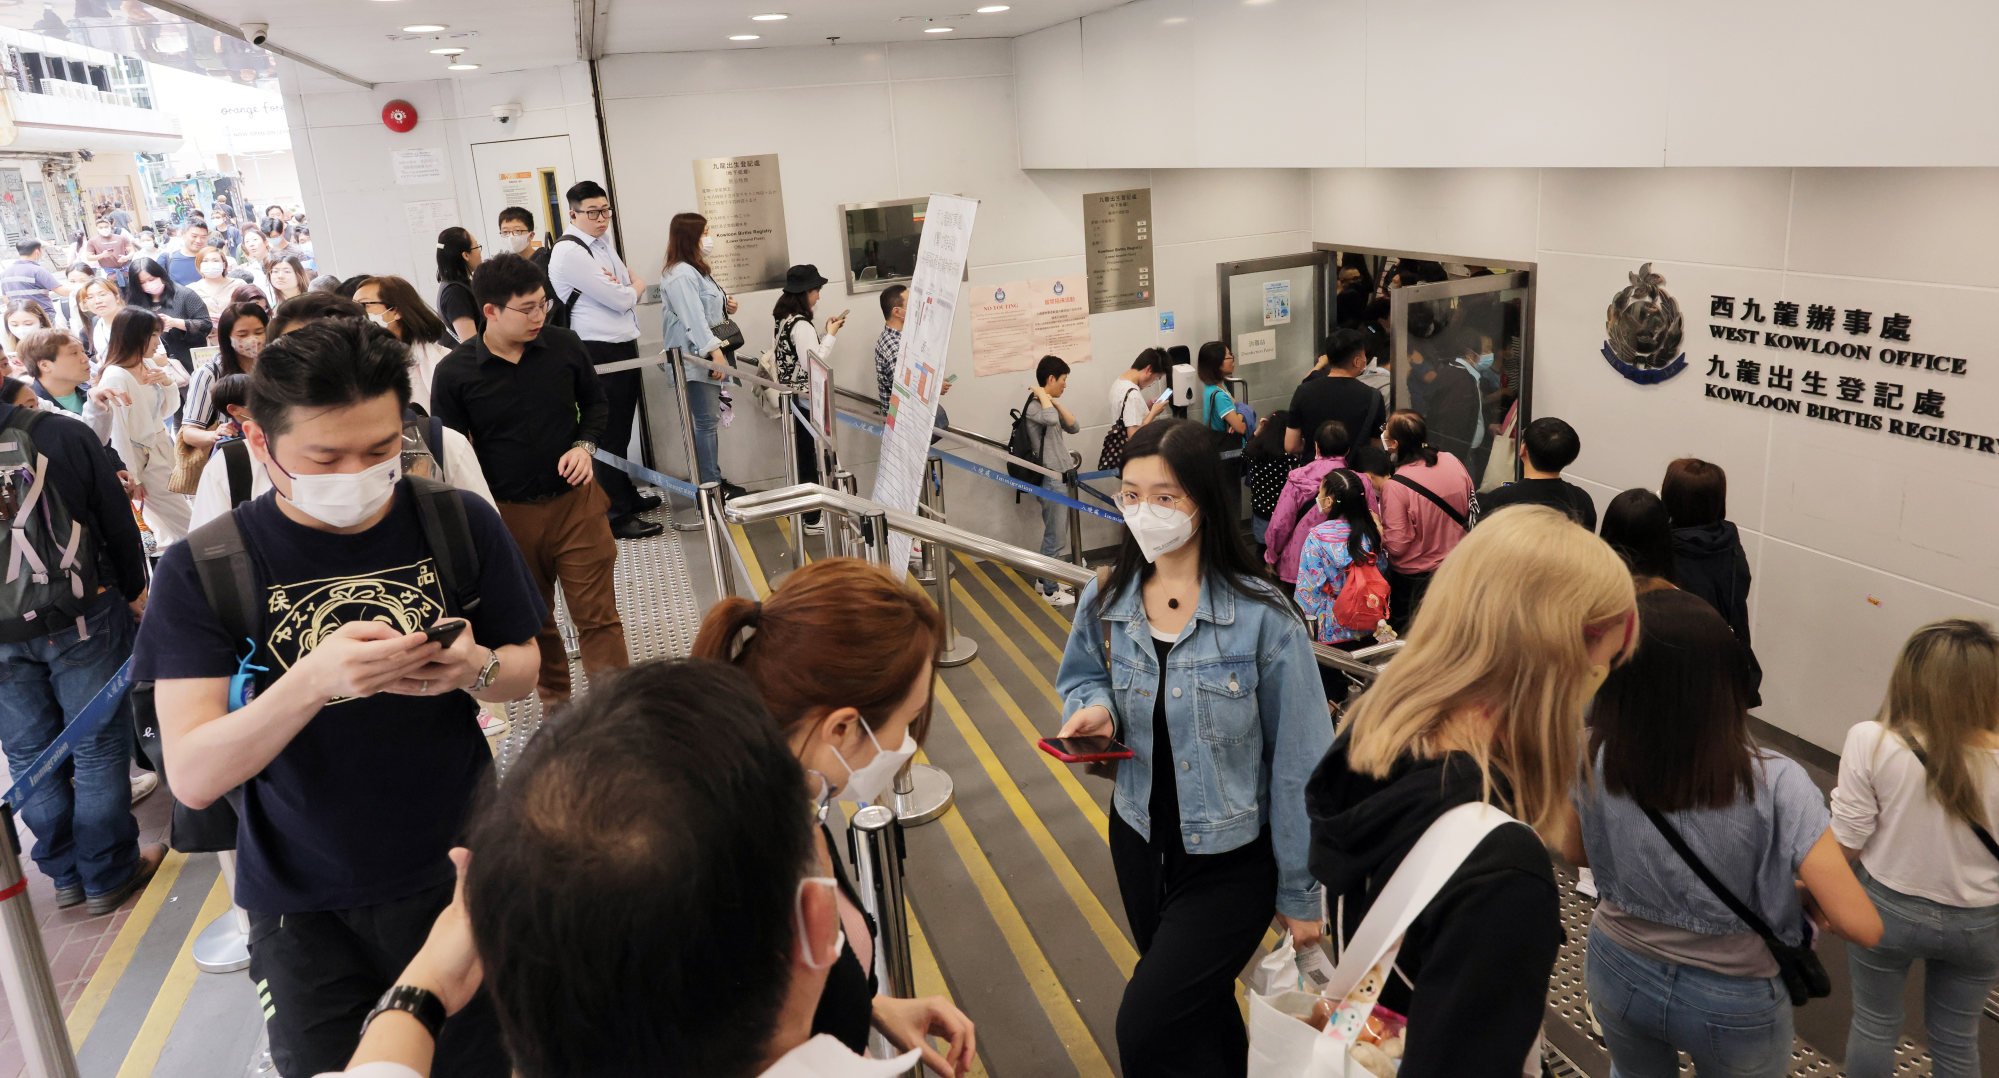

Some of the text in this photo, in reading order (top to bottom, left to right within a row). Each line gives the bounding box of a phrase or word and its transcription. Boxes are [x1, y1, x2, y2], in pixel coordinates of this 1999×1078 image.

[221, 106, 259, 119] orange
[1710, 295, 1912, 342] 西九龍辦事處
[1709, 324, 1967, 375] WEST KOWLOON OFFICE
[1706, 354, 1946, 419] 九龍出生登記處
[1705, 383, 1801, 414] KOWLOON
[1806, 402, 1882, 431] BIRTHS
[666, 479, 696, 497] Immigration
[995, 474, 1033, 493] Immigration
[417, 564, 435, 587] 品
[268, 590, 292, 613] 保
[29, 741, 70, 787] Immigration
